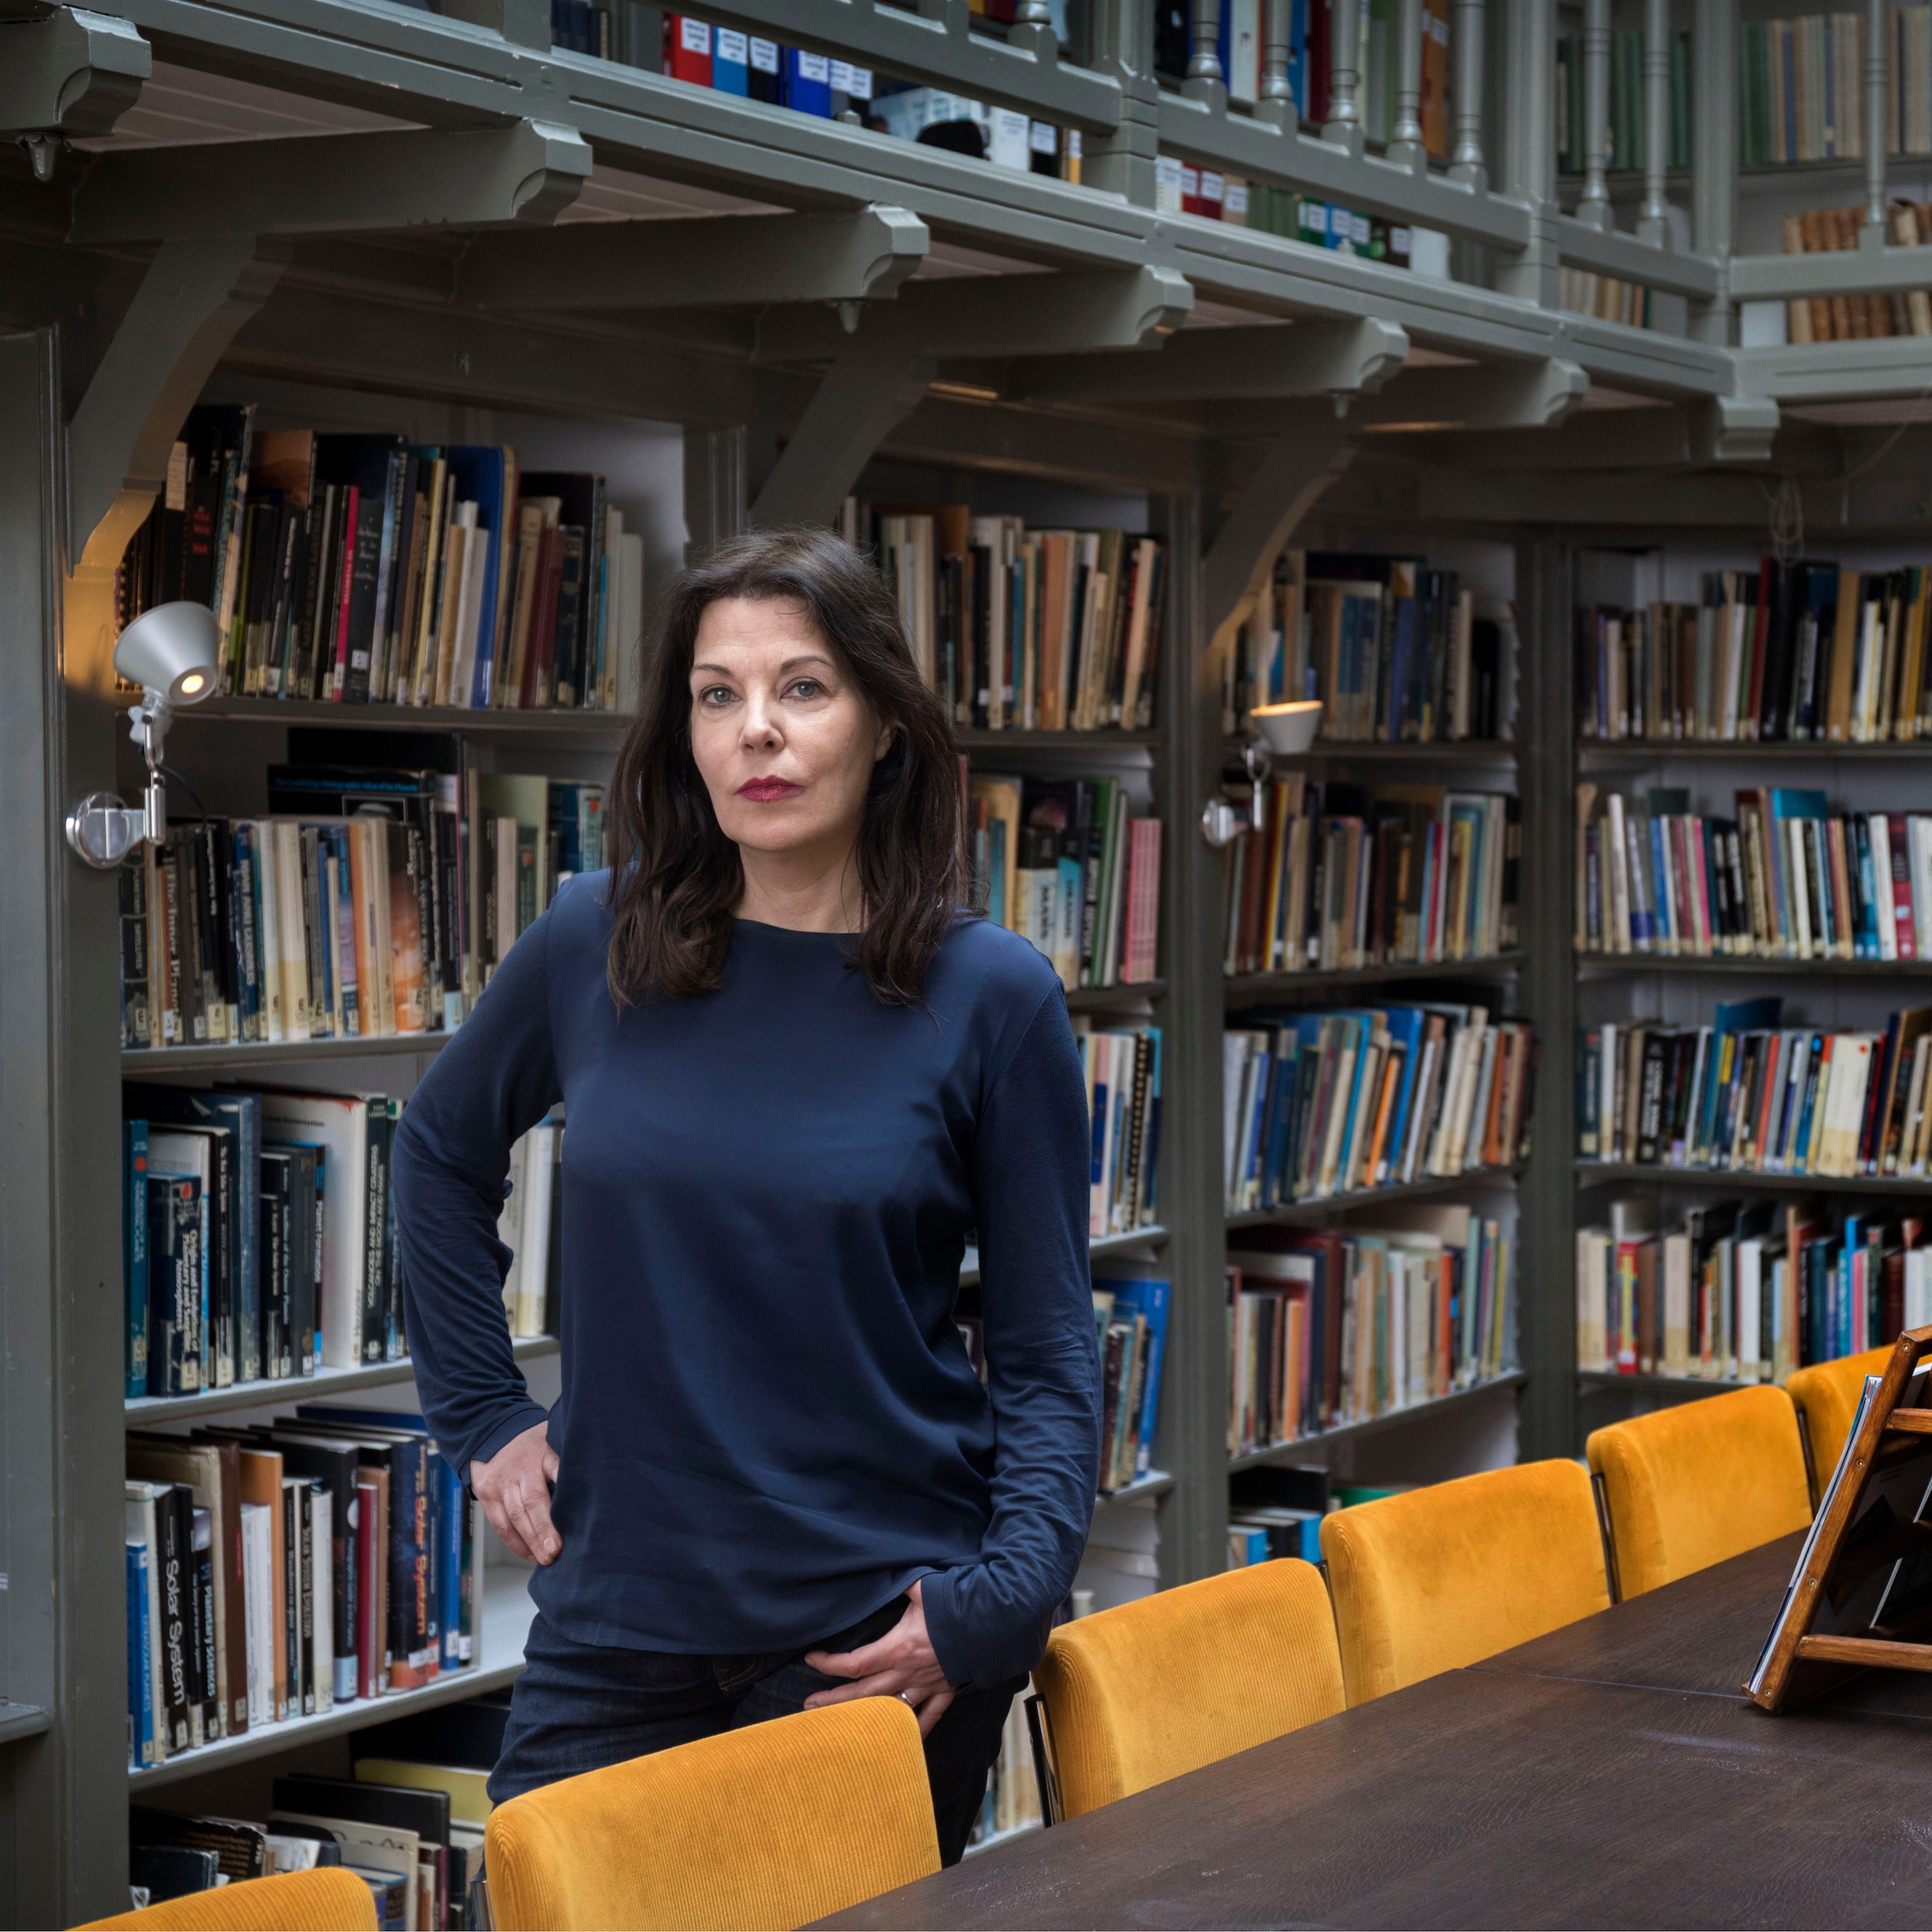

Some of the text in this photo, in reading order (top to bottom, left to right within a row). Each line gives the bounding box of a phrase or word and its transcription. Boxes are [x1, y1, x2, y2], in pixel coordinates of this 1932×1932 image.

[394, 783, 418, 792] Planets
[282, 1242, 289, 1253] of
[313, 1198, 323, 1283] Planet Formation
[367, 1144, 379, 1308] VOLCANOES AND IMPACT CRATERS
[375, 1215, 383, 1247] MOON
[175, 1259, 184, 1331] Atmospheres
[181, 1234, 192, 1352] Planetary and Satellite
[189, 1229, 199, 1352] Origin and Evolution of
[412, 1495, 428, 1637] Solar System
[165, 1558, 186, 1705] Solar System
[192, 1647, 201, 1673] System
[203, 1584, 217, 1698] Planetary Sciences
